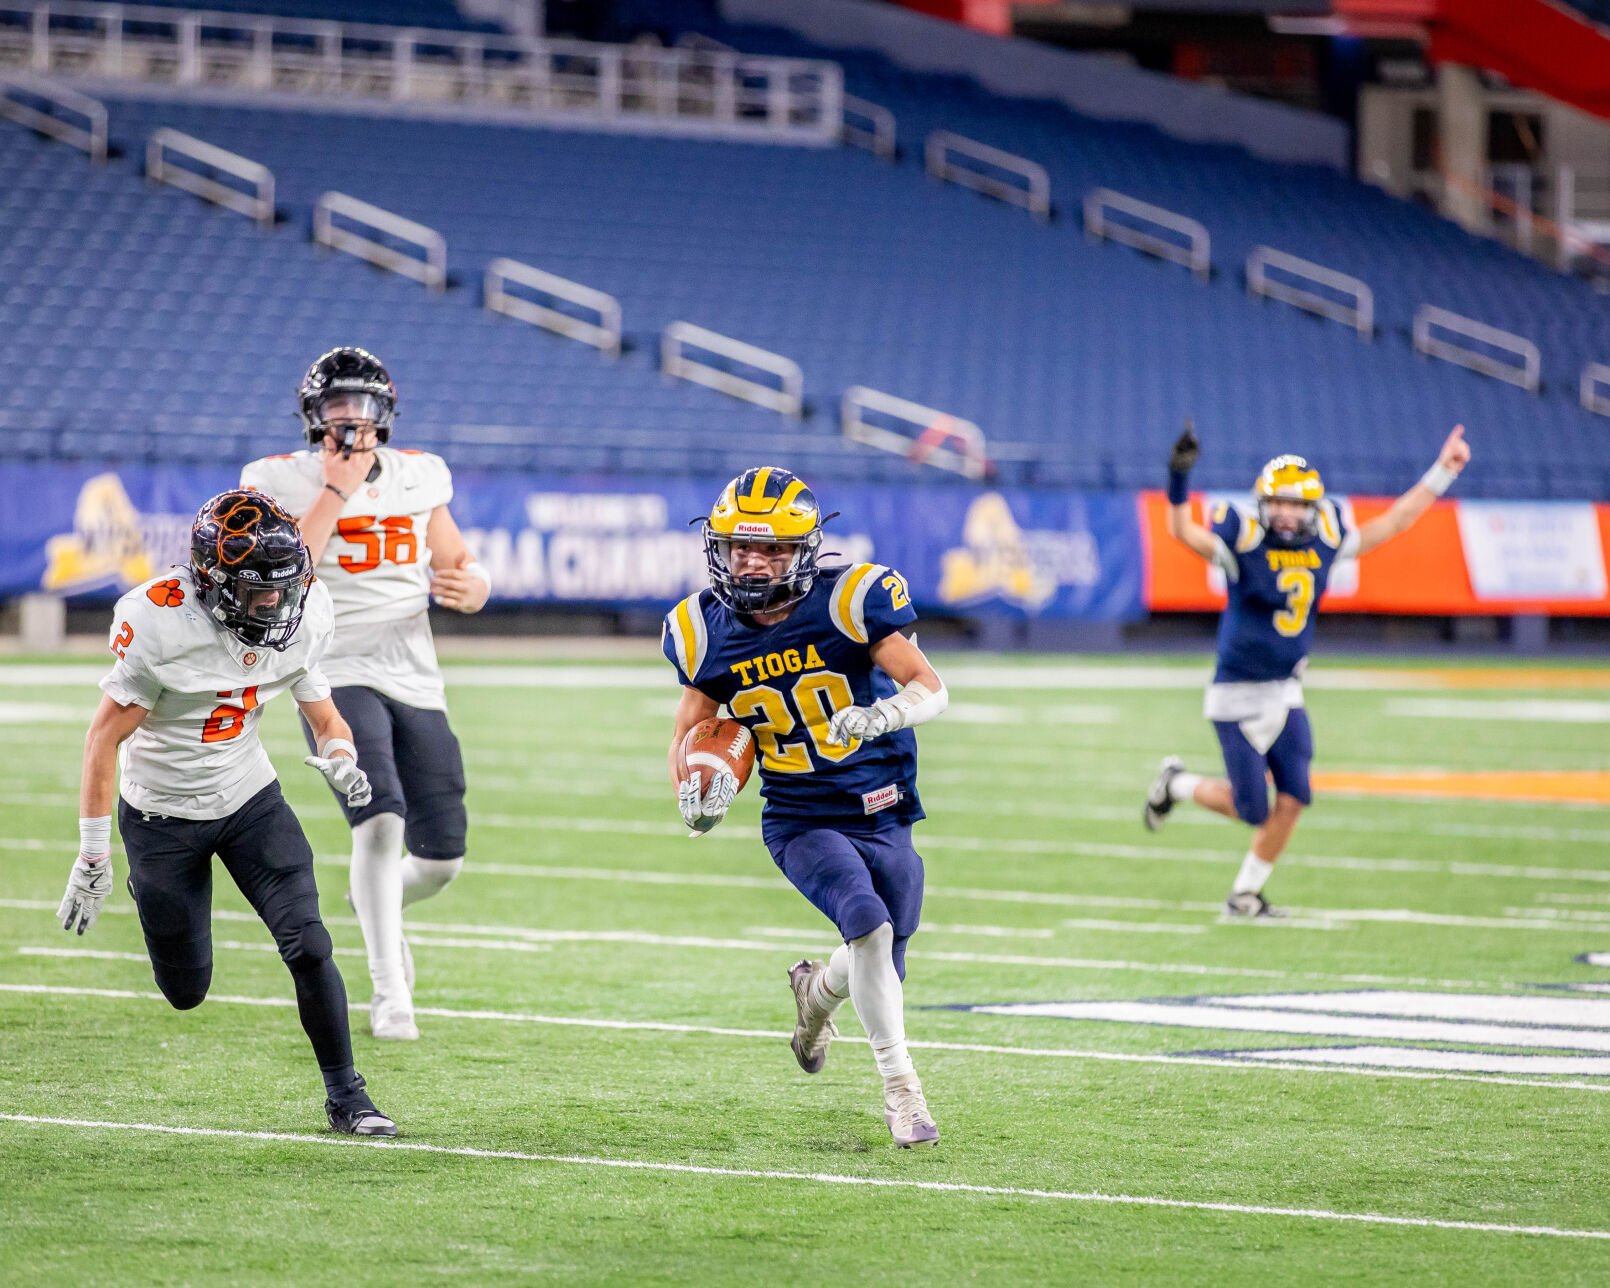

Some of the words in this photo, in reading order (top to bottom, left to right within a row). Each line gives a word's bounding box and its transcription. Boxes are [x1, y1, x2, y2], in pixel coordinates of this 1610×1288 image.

[337, 515, 418, 574] 56
[738, 524, 769, 533] Riddell
[272, 566, 297, 579] Riddell
[1272, 566, 1315, 637] 3
[110, 621, 135, 661] 2
[730, 644, 826, 687] TIOGA
[200, 684, 260, 744] 2
[729, 669, 863, 774] 20
[867, 789, 894, 805] Riddell
